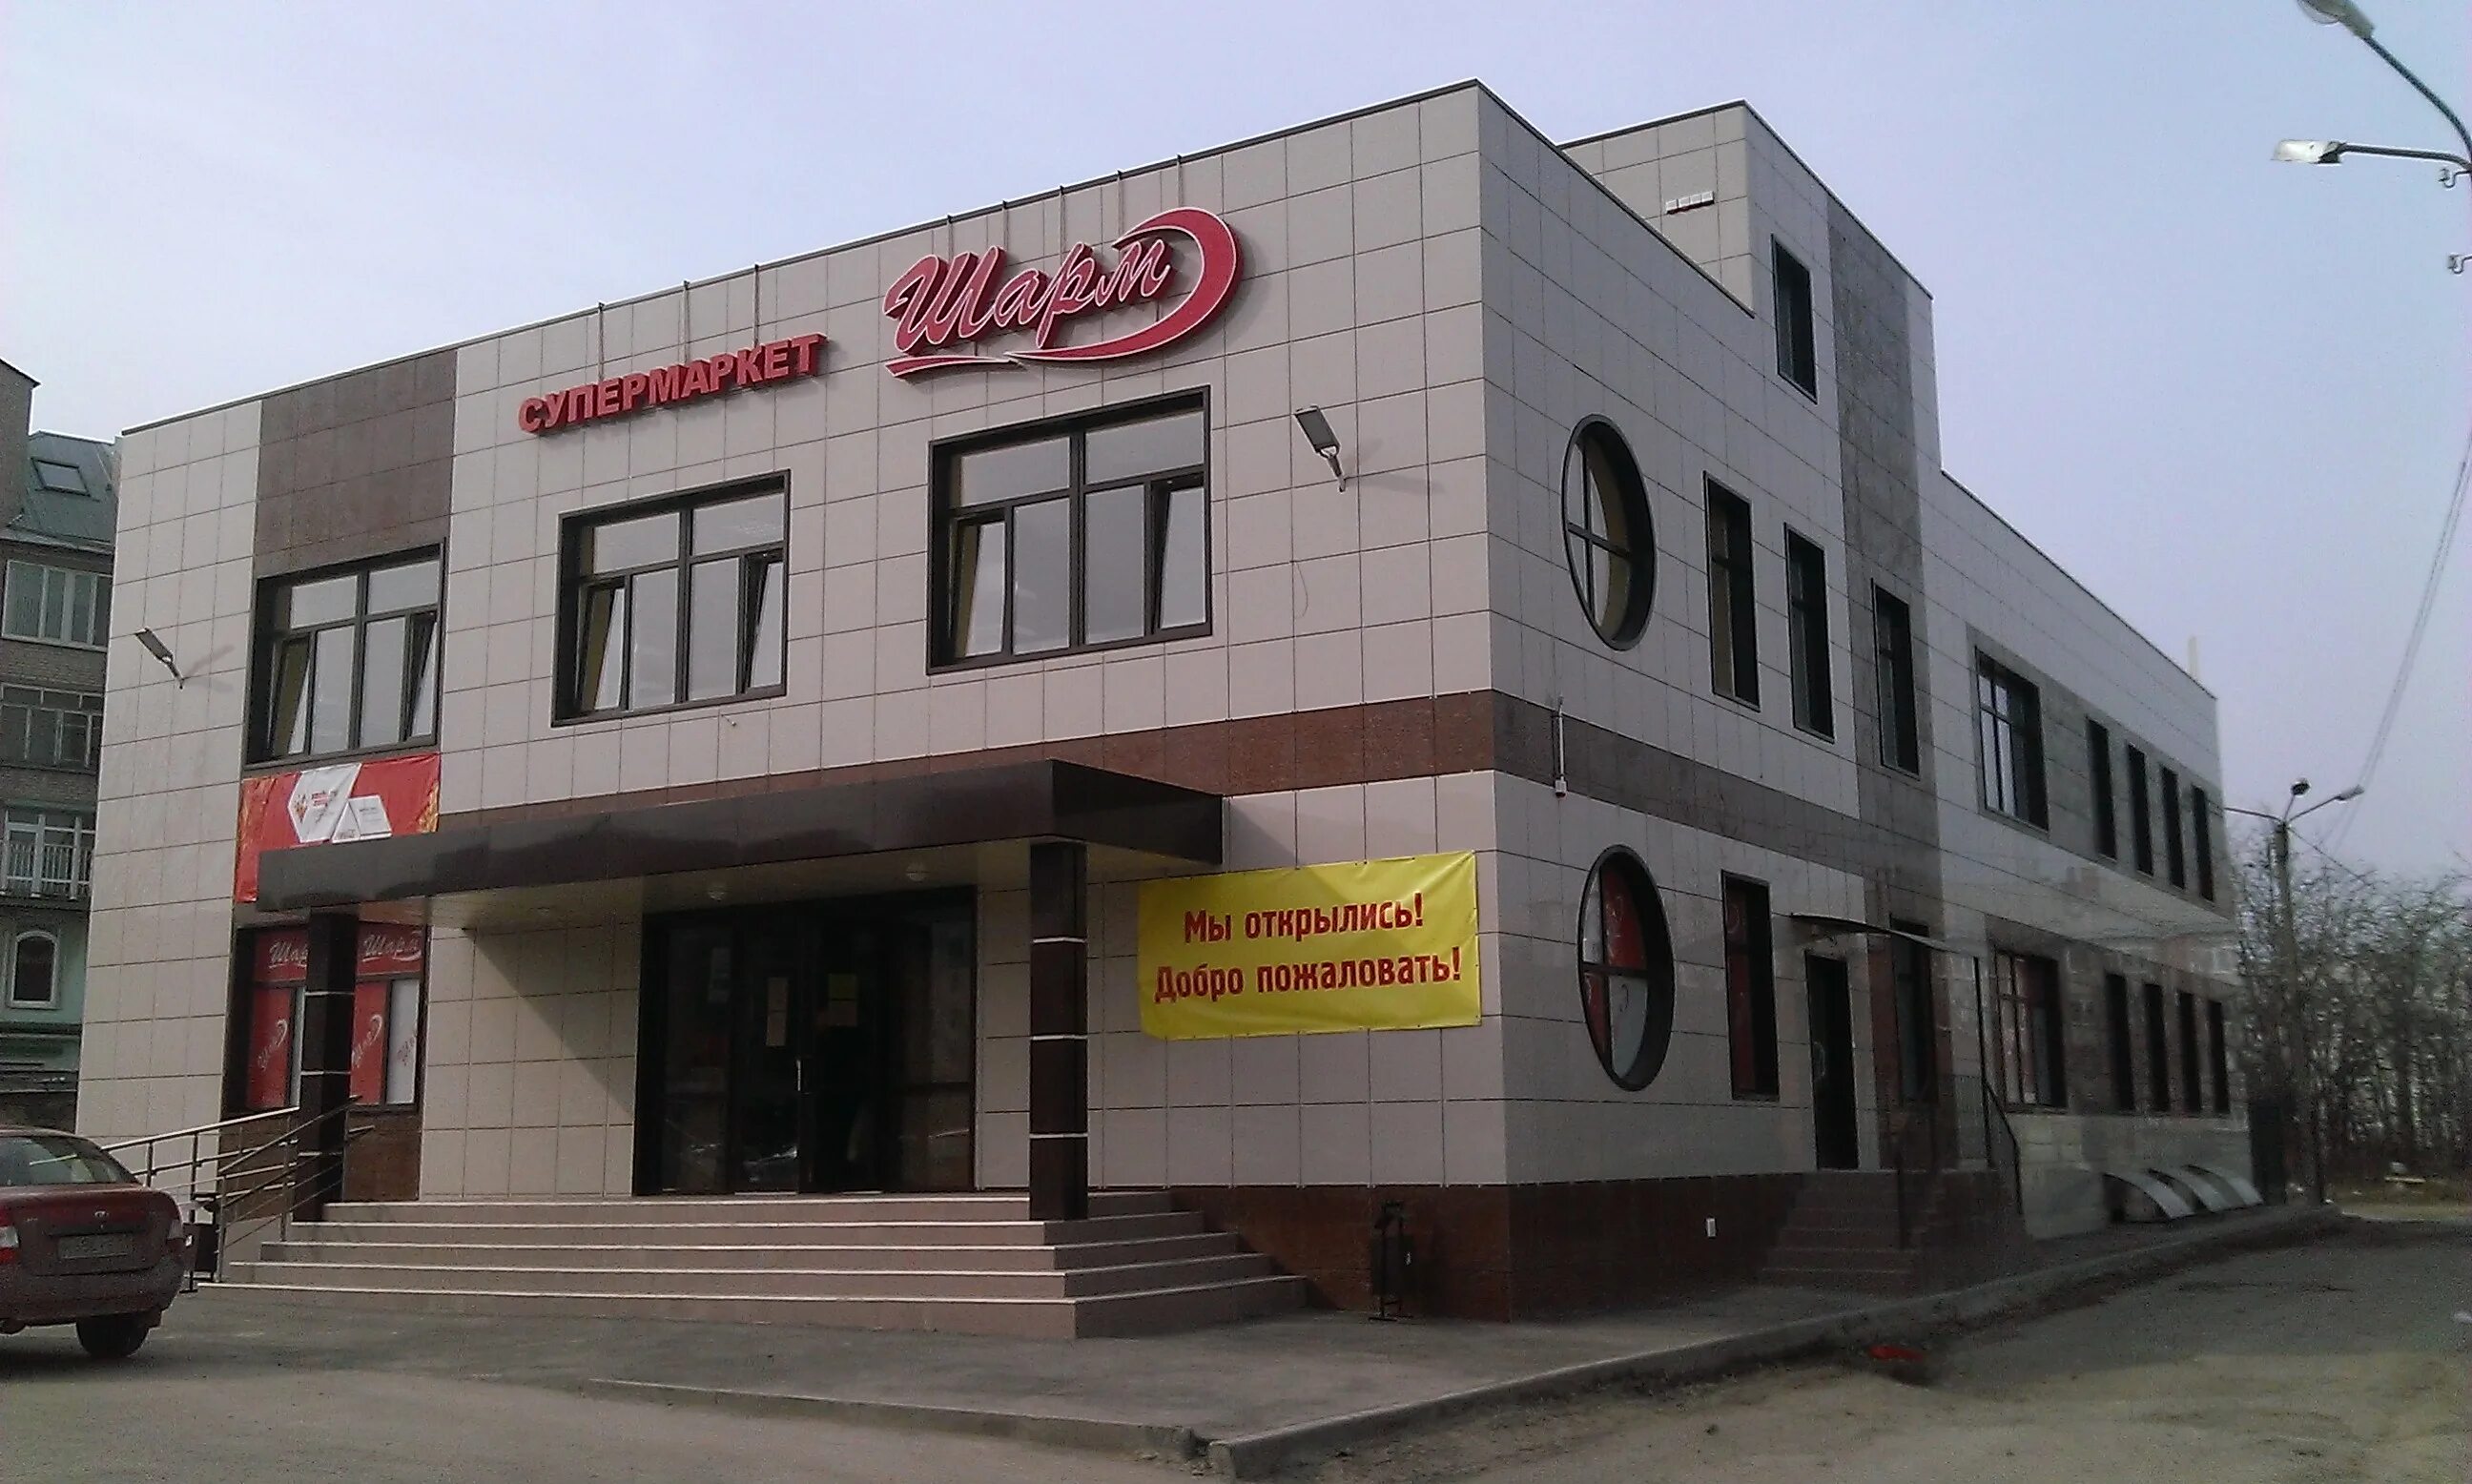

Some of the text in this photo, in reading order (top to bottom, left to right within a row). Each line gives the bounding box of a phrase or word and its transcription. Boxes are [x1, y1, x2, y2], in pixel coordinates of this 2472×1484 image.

[519, 333, 828, 433] СУПЕРМАРКЕТ
[1184, 892, 1424, 944] Мы открылись!
[1154, 946, 1462, 1004] Добро пожаловать!
